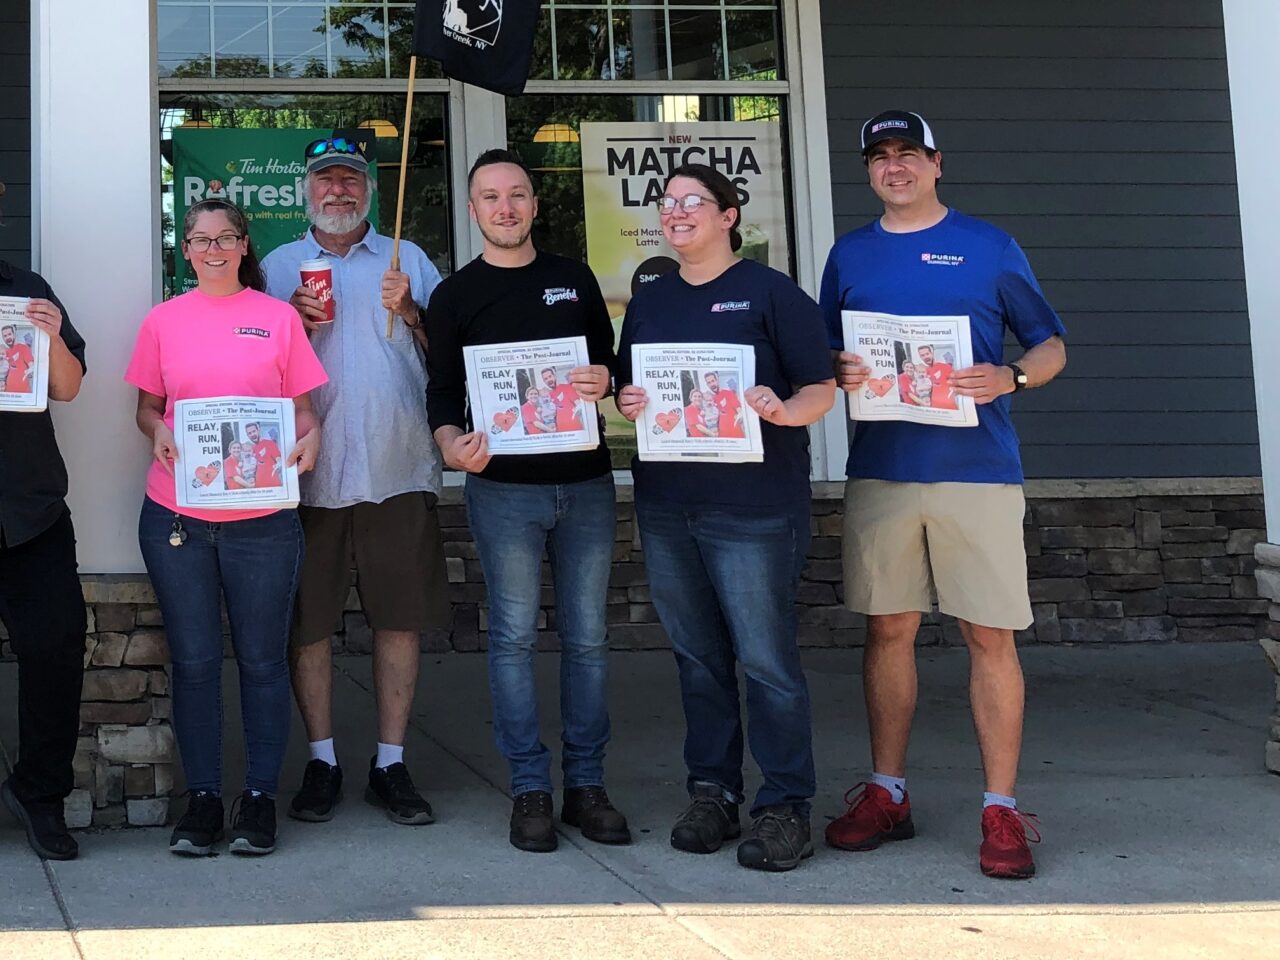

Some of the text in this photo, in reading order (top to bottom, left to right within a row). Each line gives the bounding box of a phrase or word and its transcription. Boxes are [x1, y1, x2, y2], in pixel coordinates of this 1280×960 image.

[475, 39, 488, 50] NY
[668, 135, 692, 144] NEW
[607, 146, 762, 176] MATCHA
[239, 158, 308, 174] Tim Horton
[622, 177, 750, 207] LAS
[252, 211, 273, 220] with
[274, 211, 293, 220] real
[620, 228, 639, 237] Iced
[636, 239, 660, 247] Latte
[931, 254, 963, 262] PURINA
[304, 276, 327, 292] Tim
[542, 288, 578, 306] Beneful
[241, 328, 269, 337] PURINA
[858, 337, 892, 347] RELAY,
[870, 348, 894, 358] RUN,
[875, 359, 895, 369] FUN
[481, 369, 514, 380] RELAY,
[645, 370, 679, 380] RELAY,
[493, 381, 516, 390] RUN,
[657, 381, 680, 391] RUN,
[498, 392, 518, 401] FUN
[662, 393, 681, 401] FUN
[188, 408, 221, 417] OBSERVER
[187, 423, 219, 432] RELAY,
[198, 434, 220, 443] RUN,
[202, 446, 220, 455] FUN
